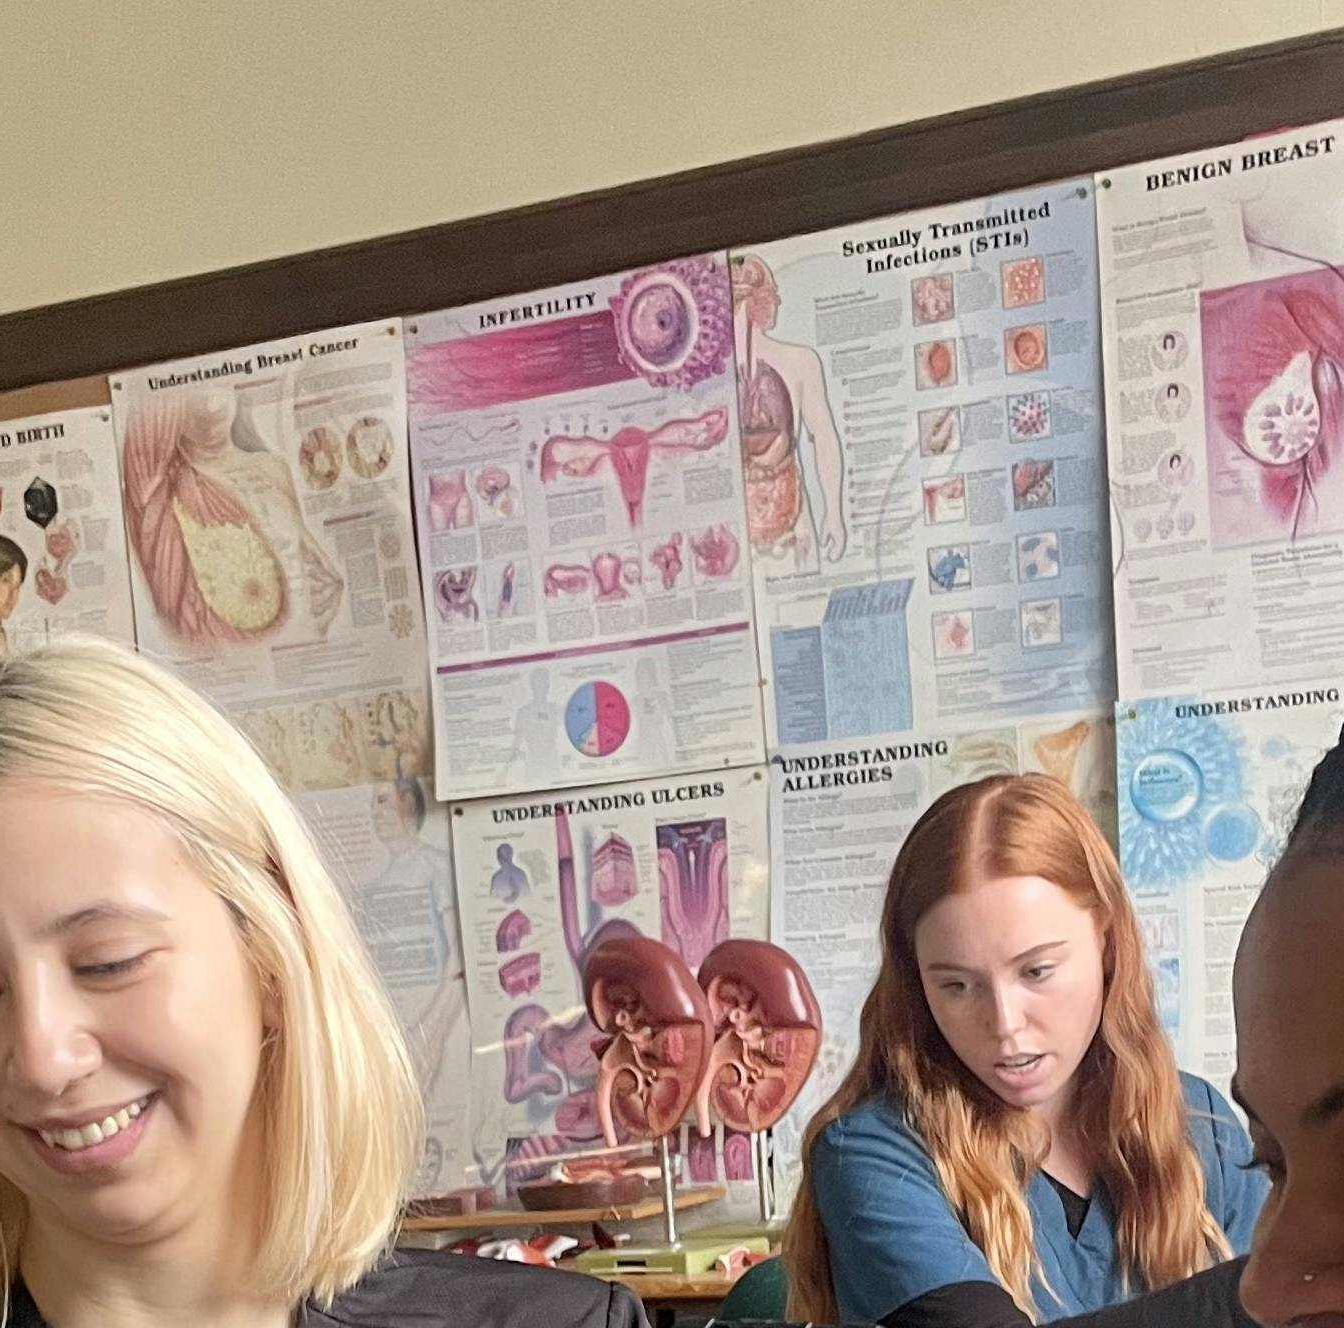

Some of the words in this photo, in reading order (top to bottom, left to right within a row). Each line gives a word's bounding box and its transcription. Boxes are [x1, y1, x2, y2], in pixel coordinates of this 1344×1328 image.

[1146, 157, 1233, 192] BENIGN
[1241, 136, 1336, 172] BREAST
[842, 228, 922, 258] Sexually
[928, 201, 1051, 240] Transmitted
[866, 245, 962, 274] Infections
[969, 228, 1030, 257] (STIs)
[479, 292, 597, 329] INFERTILITY
[148, 356, 254, 391] Understanding
[257, 346, 305, 369] Breast
[309, 336, 359, 359] Cancer
[16, 423, 66, 445] BIRTH
[1175, 688, 1340, 720] UNDERSTANDING
[780, 740, 950, 775] UNDERSTANDING
[782, 766, 894, 793] ALLERGIES
[491, 790, 647, 825] UNDERSTANDING
[651, 781, 726, 805] ULCERS
